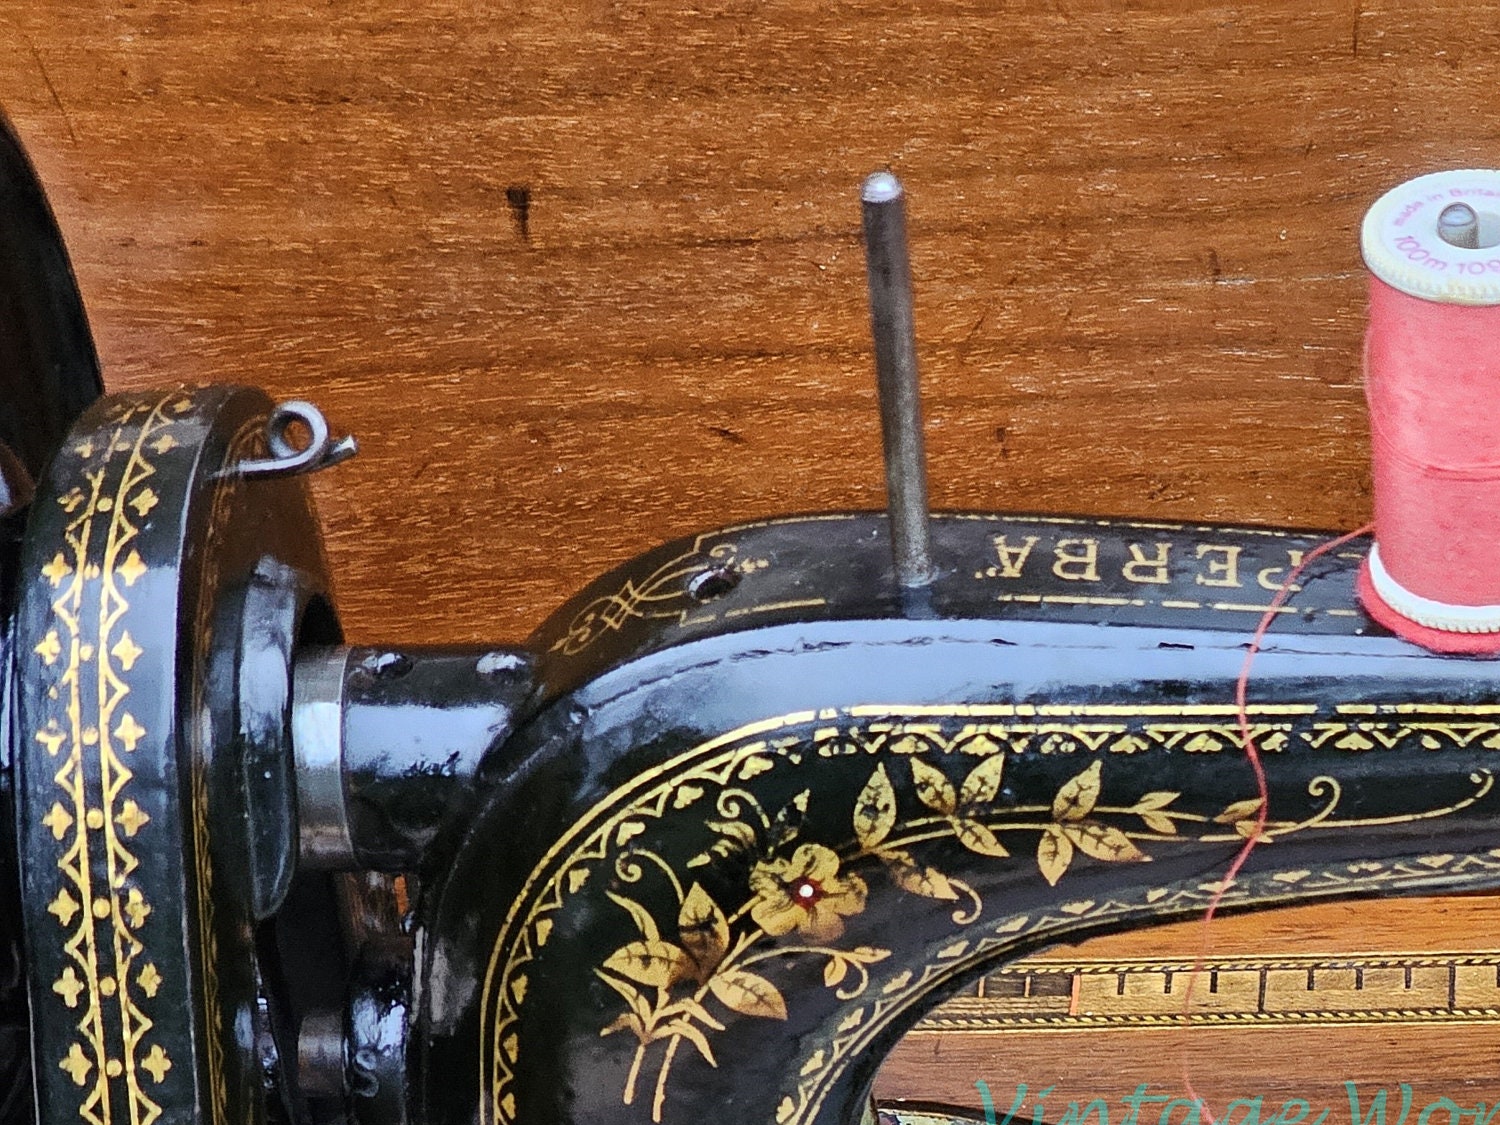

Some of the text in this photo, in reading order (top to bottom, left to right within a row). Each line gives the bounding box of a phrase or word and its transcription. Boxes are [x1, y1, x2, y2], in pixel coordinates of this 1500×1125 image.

[1394, 201, 1424, 227] made
[1427, 192, 1444, 203] in
[1394, 235, 1448, 272] 100m
